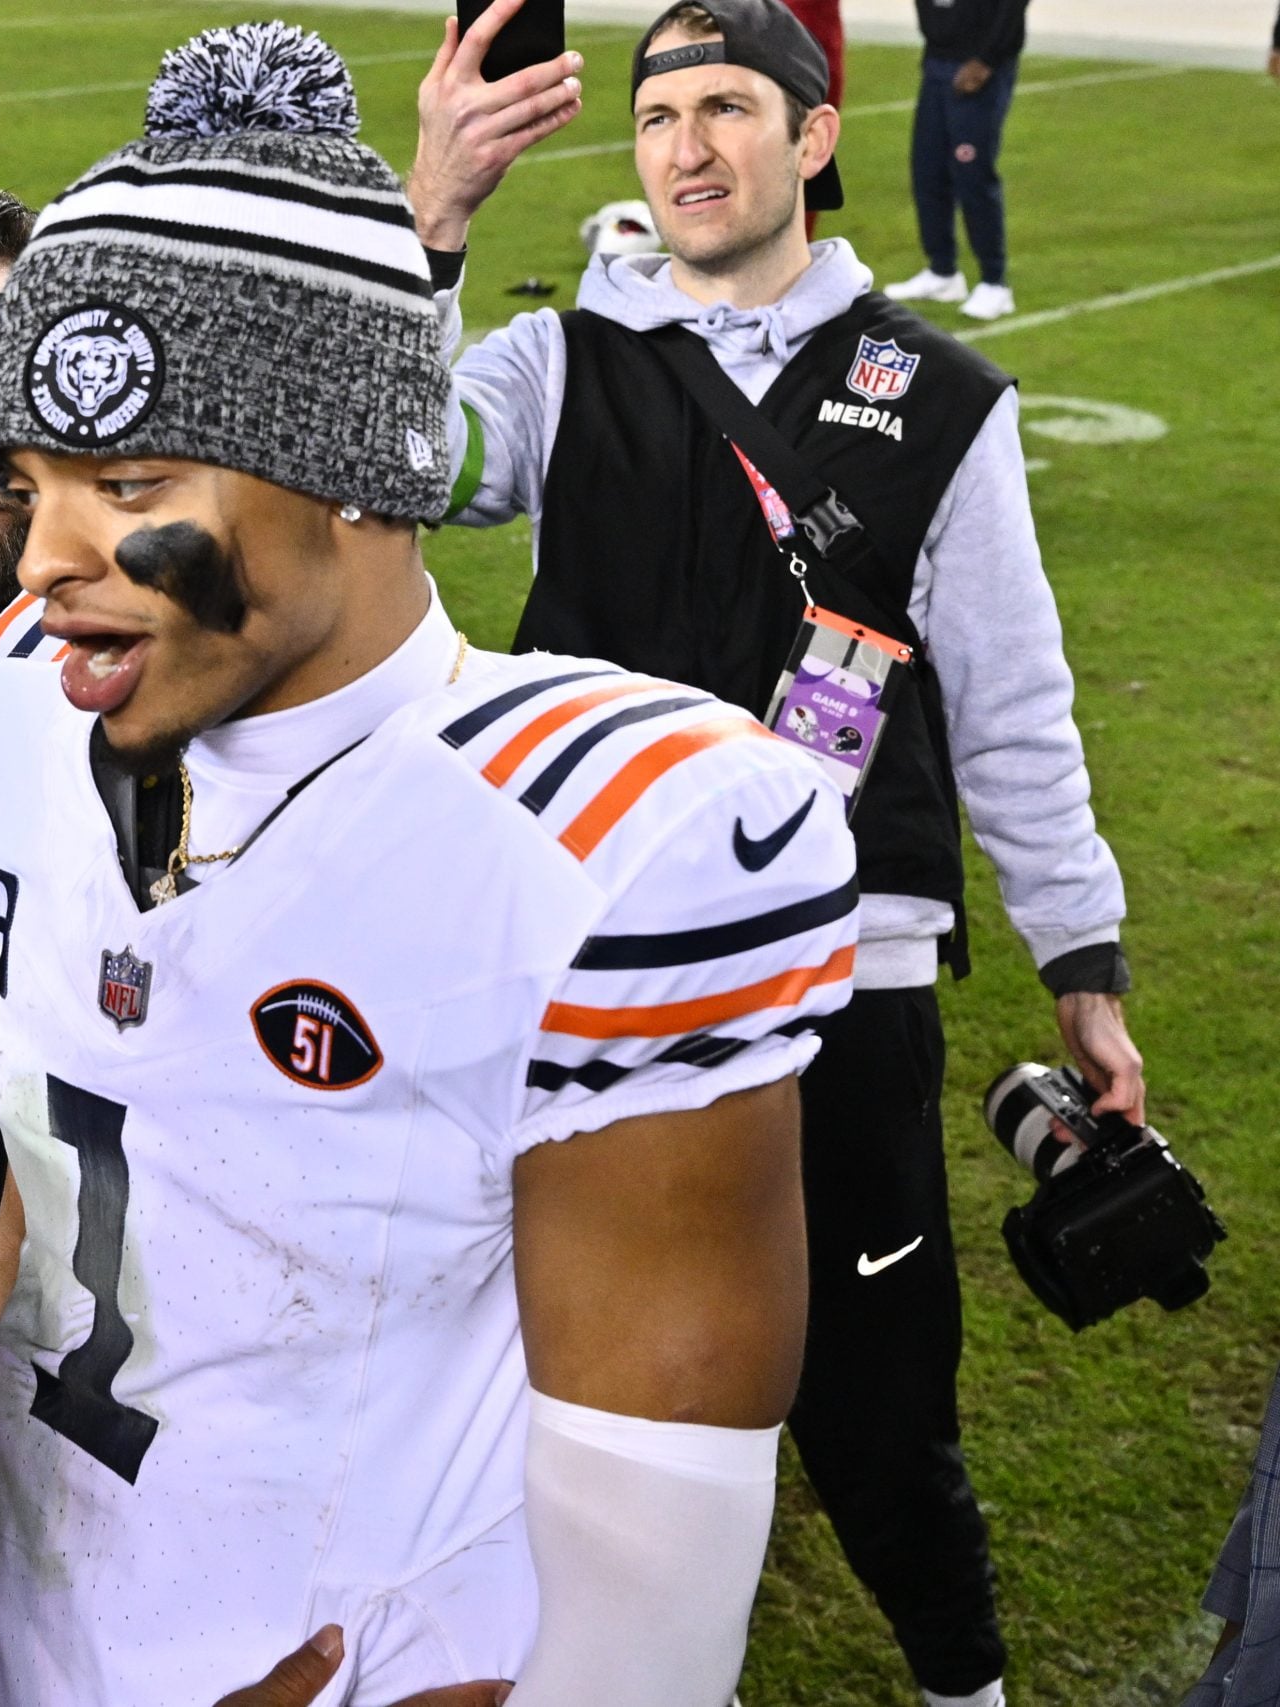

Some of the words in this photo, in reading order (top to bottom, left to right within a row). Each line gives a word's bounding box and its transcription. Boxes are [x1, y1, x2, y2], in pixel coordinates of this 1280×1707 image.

[33, 309, 110, 367] OPPORTUNITY
[123, 324, 155, 371] EQUITY
[854, 360, 901, 394] NFL
[31, 383, 75, 434] JUSTICE
[94, 387, 149, 438] FREEDOM
[818, 399, 903, 442] MEDIA
[811, 691, 848, 714] GAME
[104, 981, 138, 1017] NFL
[290, 1013, 333, 1082] 51
[29, 1072, 160, 1487] 1
